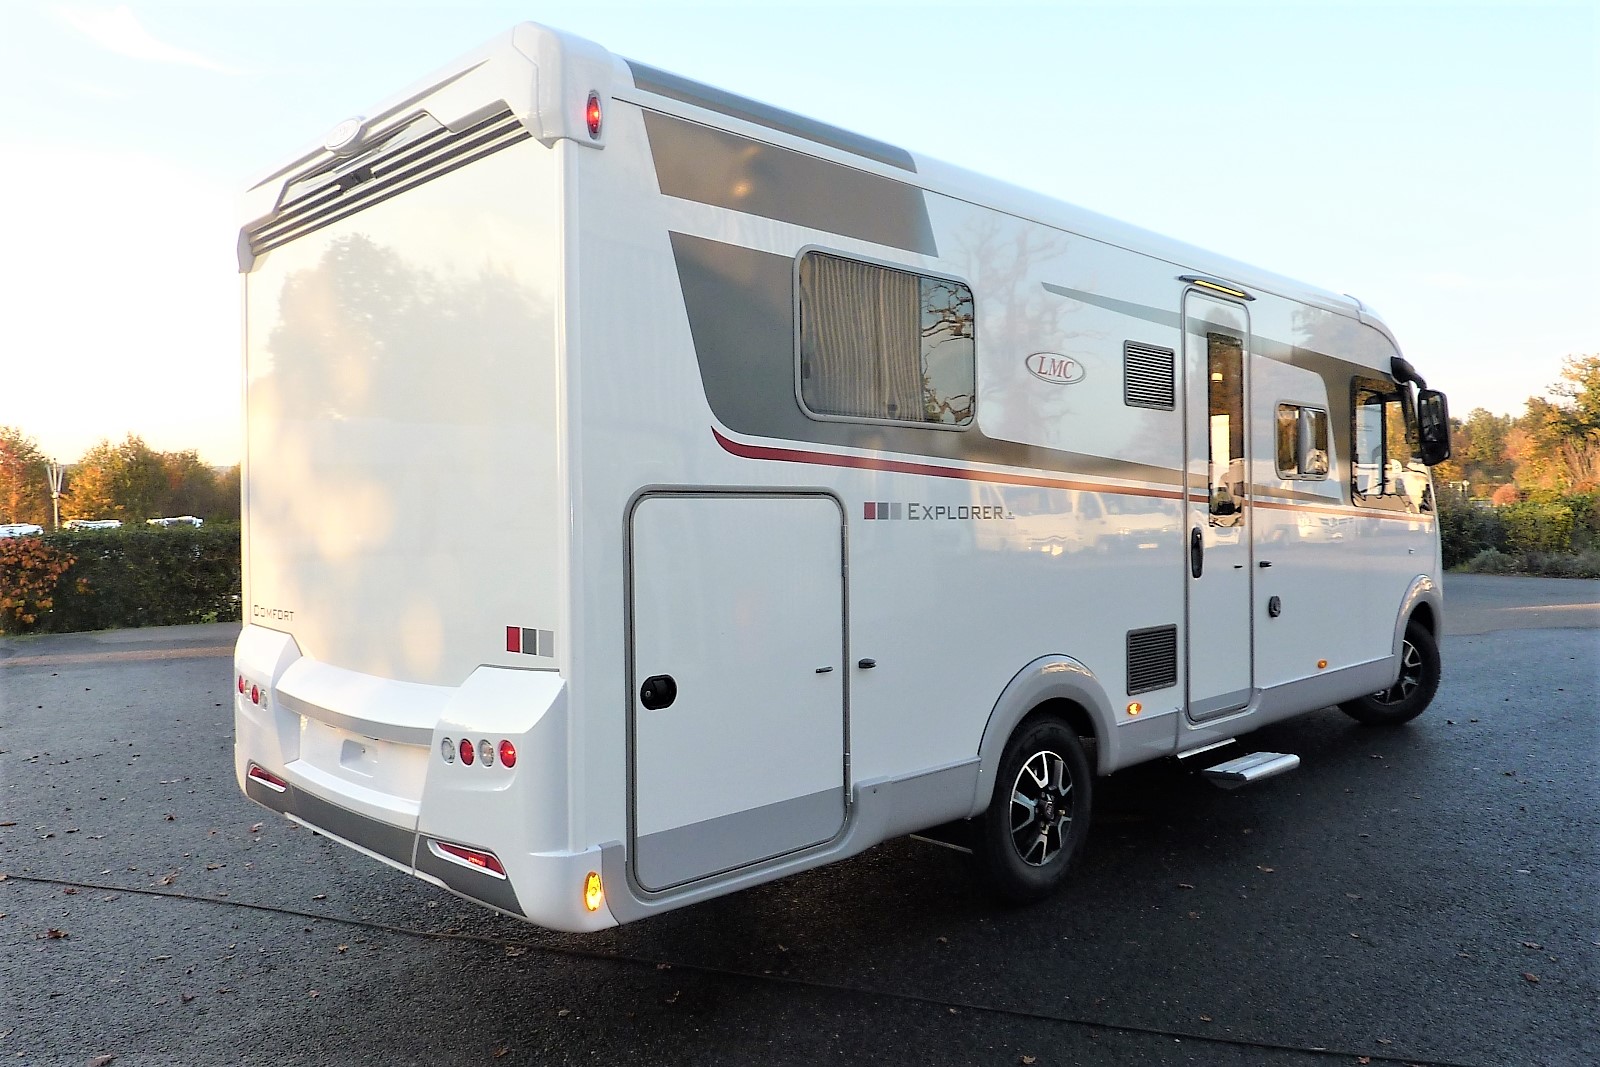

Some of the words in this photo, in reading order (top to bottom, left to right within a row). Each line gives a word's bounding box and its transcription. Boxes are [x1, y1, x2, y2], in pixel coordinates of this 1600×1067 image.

[1037, 356, 1075, 379] LMC
[908, 503, 1003, 520] EXPLORER
[253, 604, 295, 621] COMFORT
